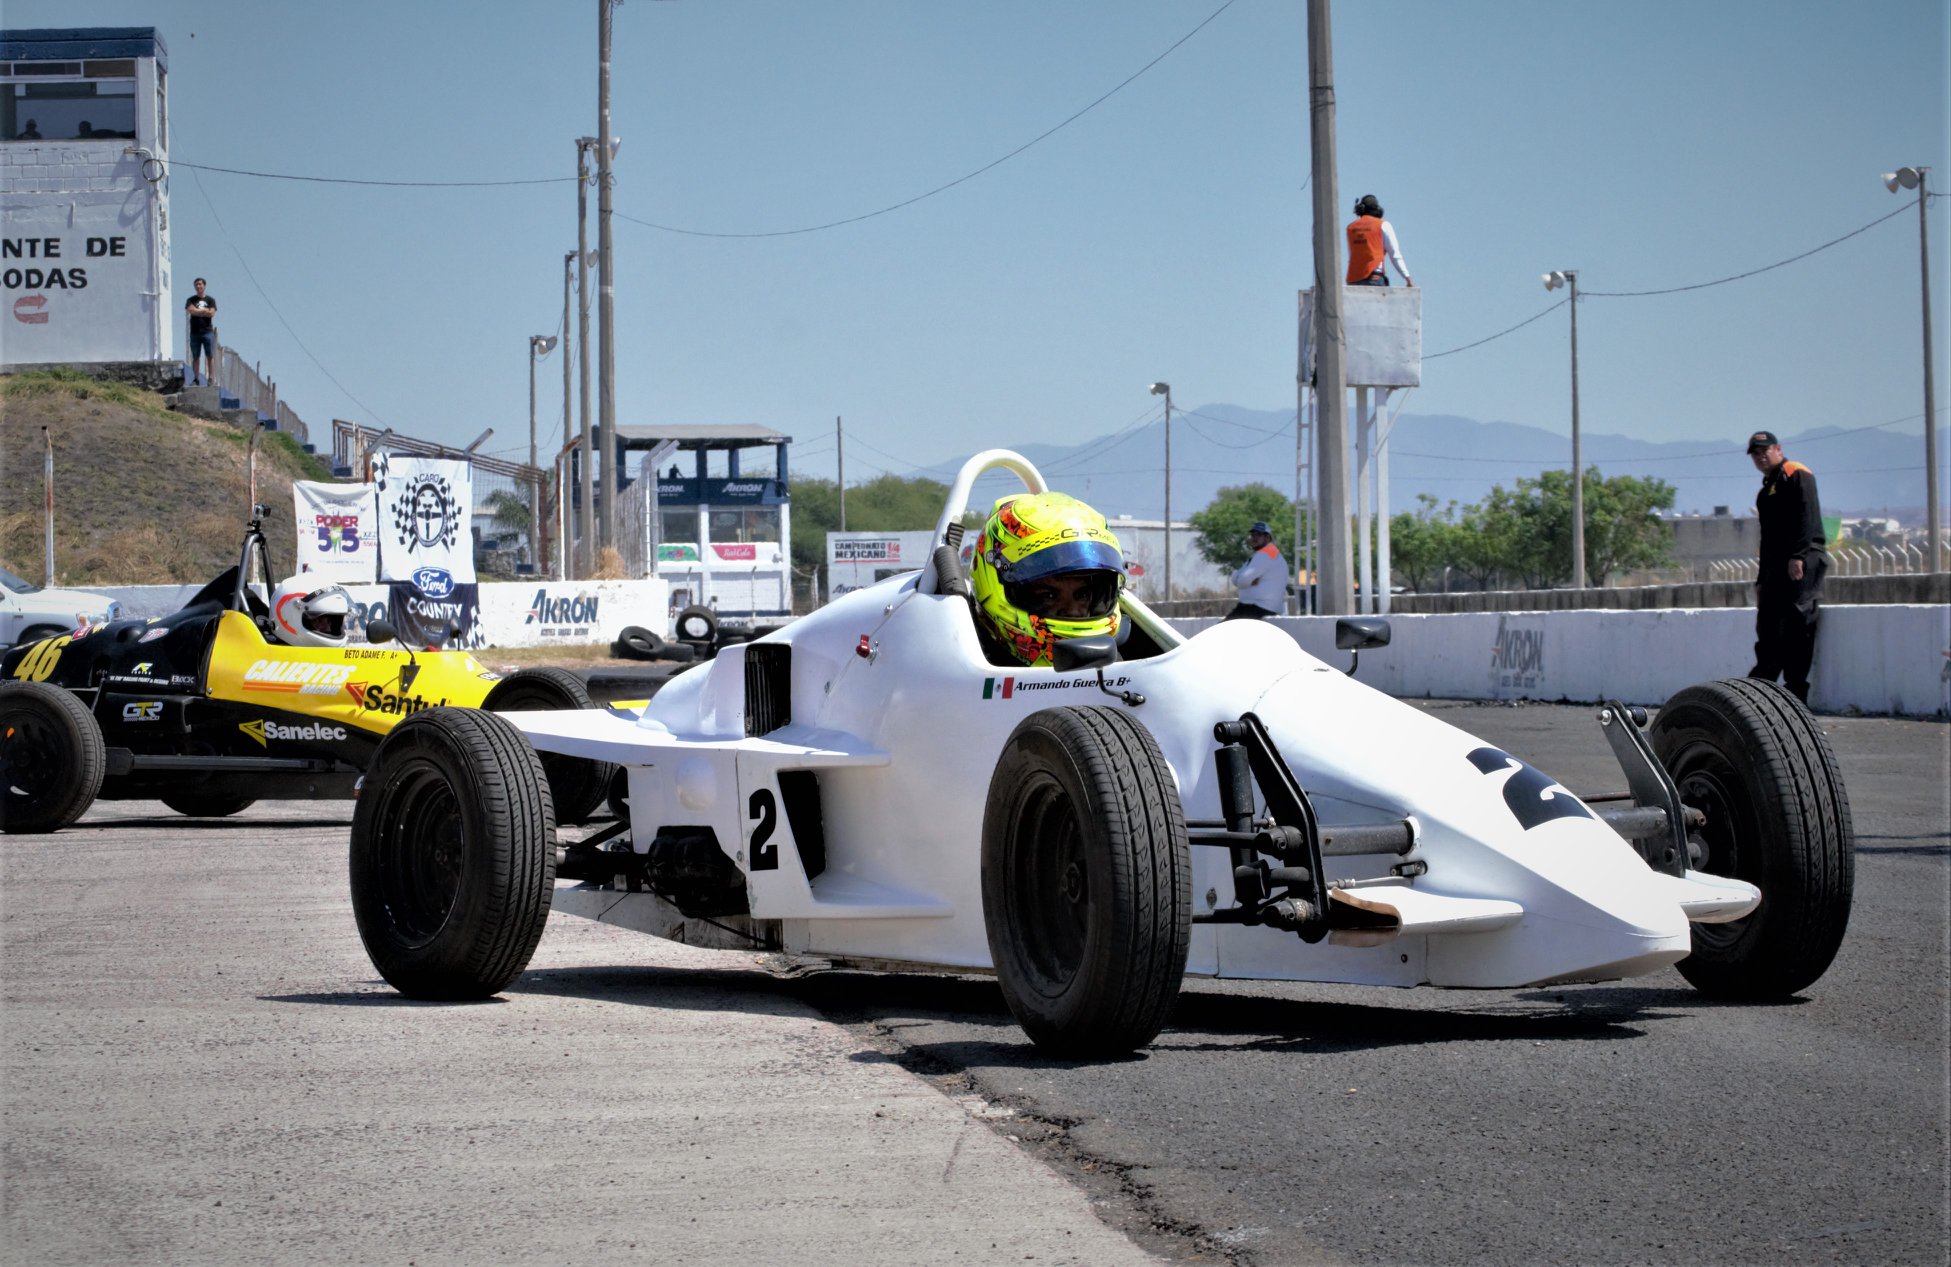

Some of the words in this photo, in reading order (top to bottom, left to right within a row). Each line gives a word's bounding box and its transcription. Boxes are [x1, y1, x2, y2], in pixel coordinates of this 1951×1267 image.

[86, 237, 126, 257] DE
[0, 268, 88, 289] ODAS
[316, 514, 359, 528] PODER
[835, 542, 886, 550] CAMPEONATO
[835, 550, 886, 559] MEXICANO
[420, 570, 448, 594] Ford
[525, 589, 599, 625] AKRON
[13, 635, 73, 683] 46
[344, 649, 360, 659] BETO
[360, 650, 381, 659] ADAME
[390, 651, 398, 659] A+
[244, 659, 357, 684] CALIENTES
[299, 684, 342, 695] RACING
[1014, 679, 1071, 691] Armando
[1072, 678, 1114, 688] Guera
[1116, 676, 1131, 686] B+
[123, 701, 164, 718] GTR
[264, 721, 348, 741] Sanelec
[1465, 746, 1596, 832] 2
[749, 788, 779, 872] 2
